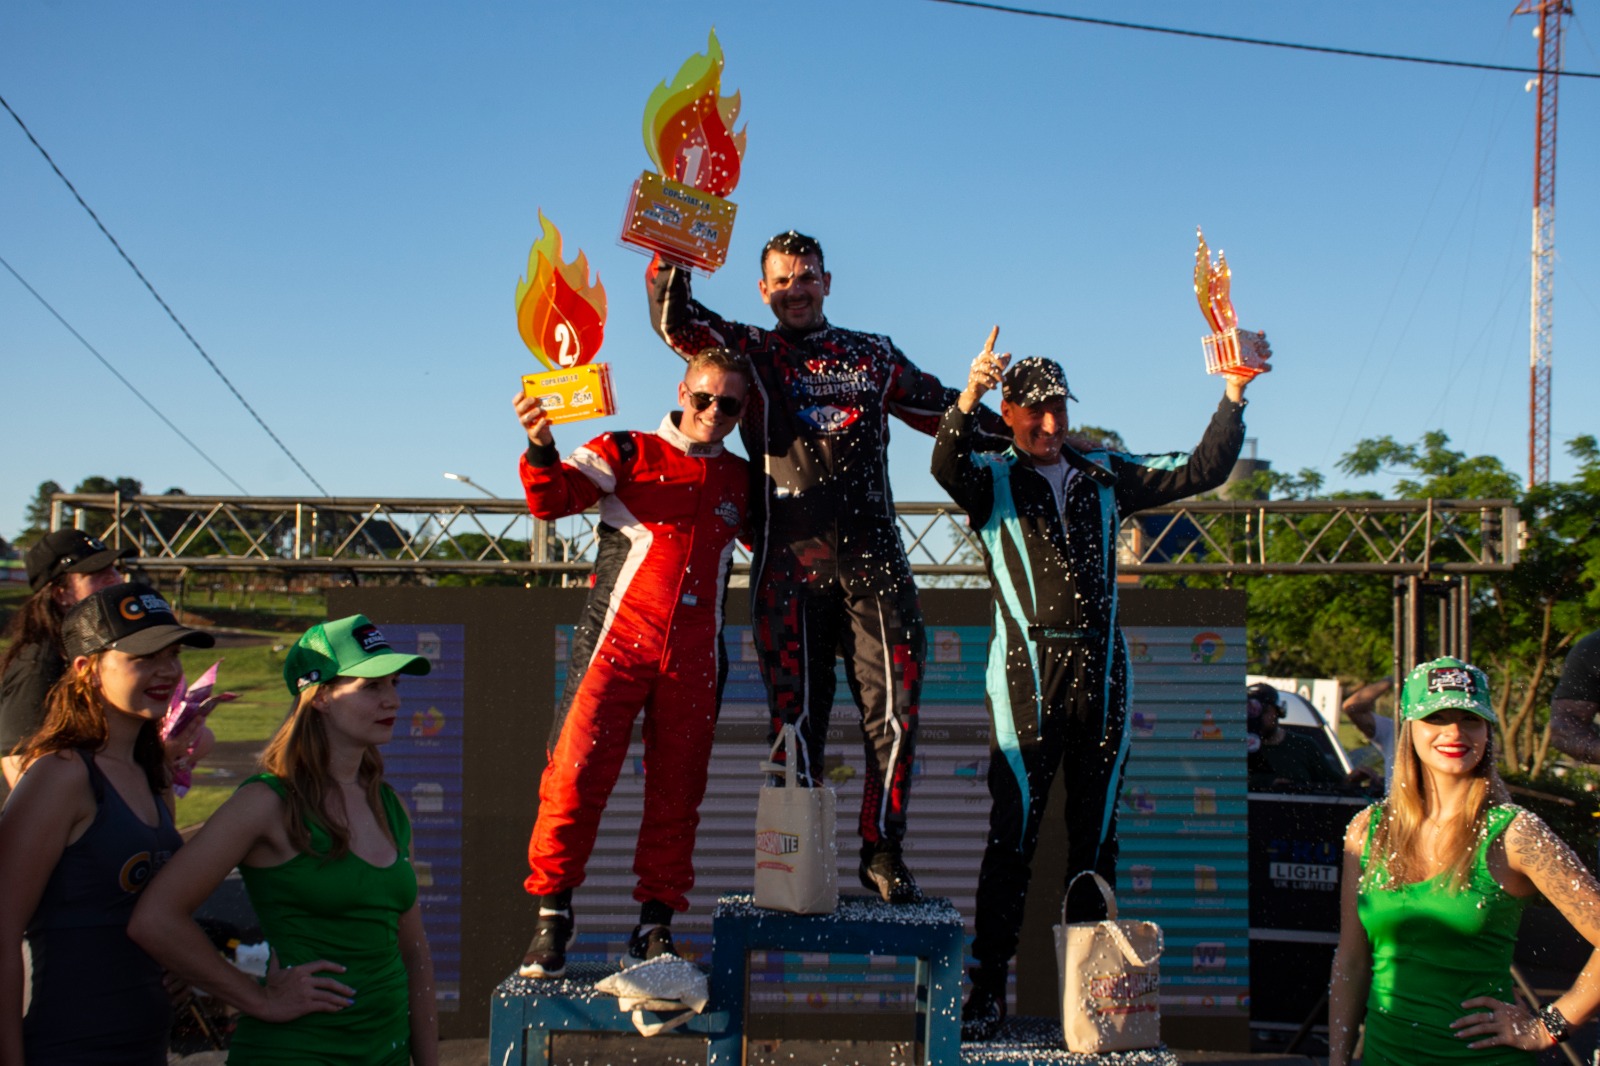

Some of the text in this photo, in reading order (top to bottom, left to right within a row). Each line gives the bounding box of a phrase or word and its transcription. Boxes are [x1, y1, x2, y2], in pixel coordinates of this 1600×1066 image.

[682, 144, 704, 188] 1
[554, 323, 574, 366] 2
[1276, 865, 1331, 880] LIGHT
